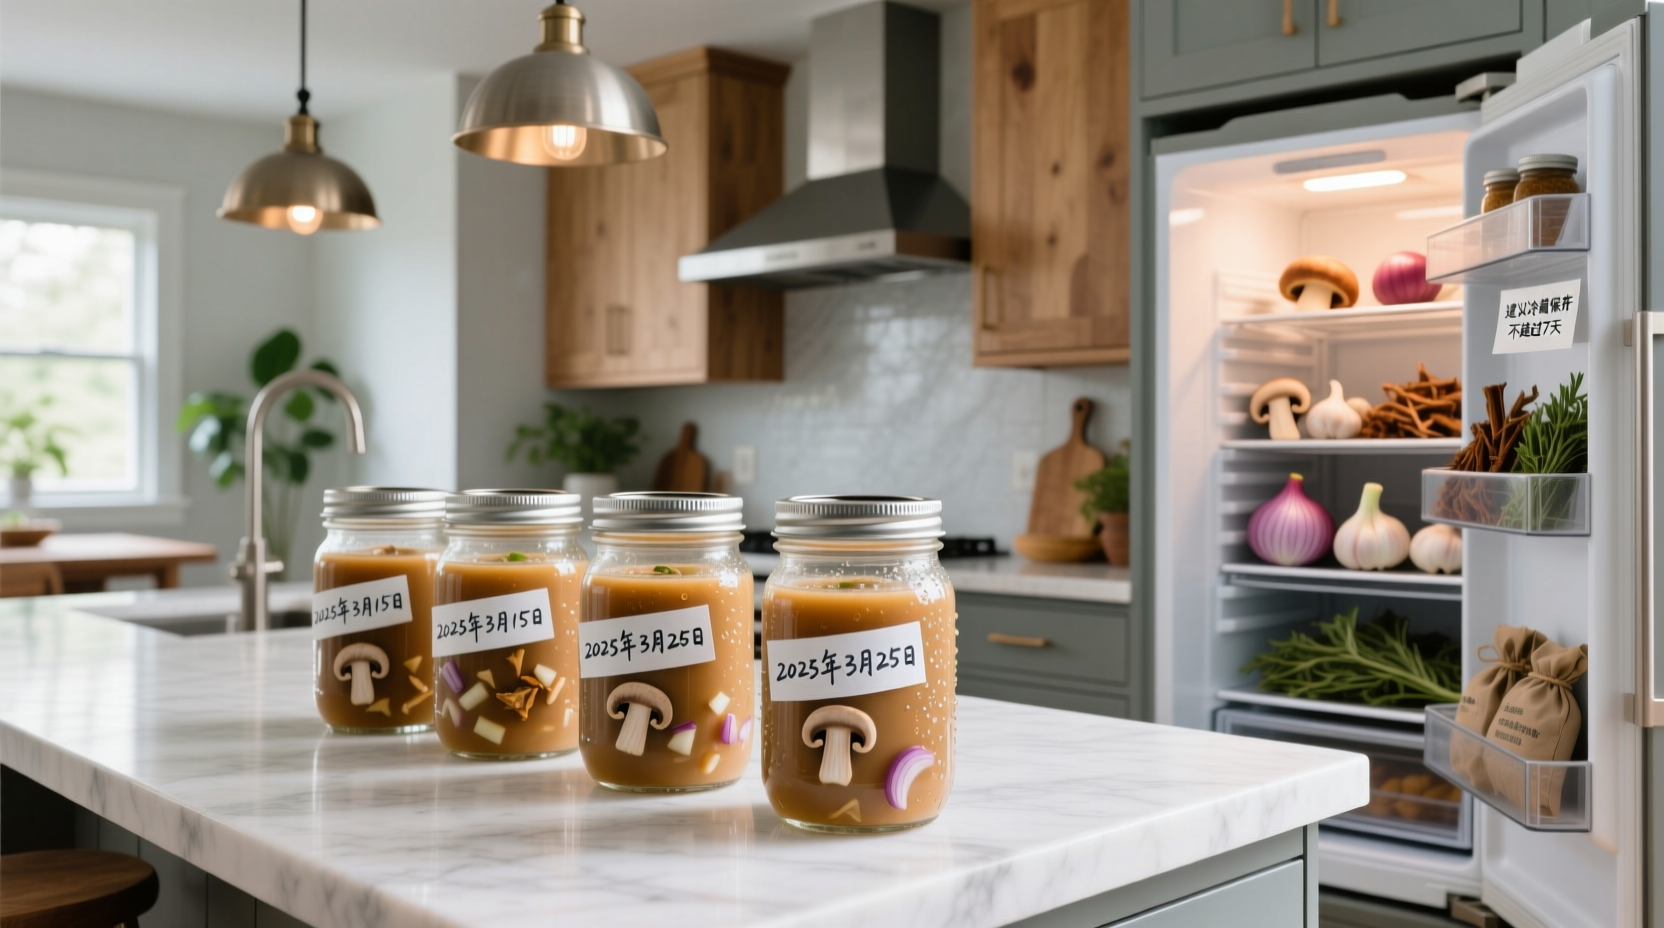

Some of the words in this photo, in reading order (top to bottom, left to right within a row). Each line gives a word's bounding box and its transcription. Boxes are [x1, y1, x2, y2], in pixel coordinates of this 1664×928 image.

[315, 593, 402, 624] 2025年3月15日
[437, 608, 542, 643] 2025年3月15日
[585, 627, 703, 661] 2025年3月25日
[776, 645, 915, 685] 2025年3月25日
